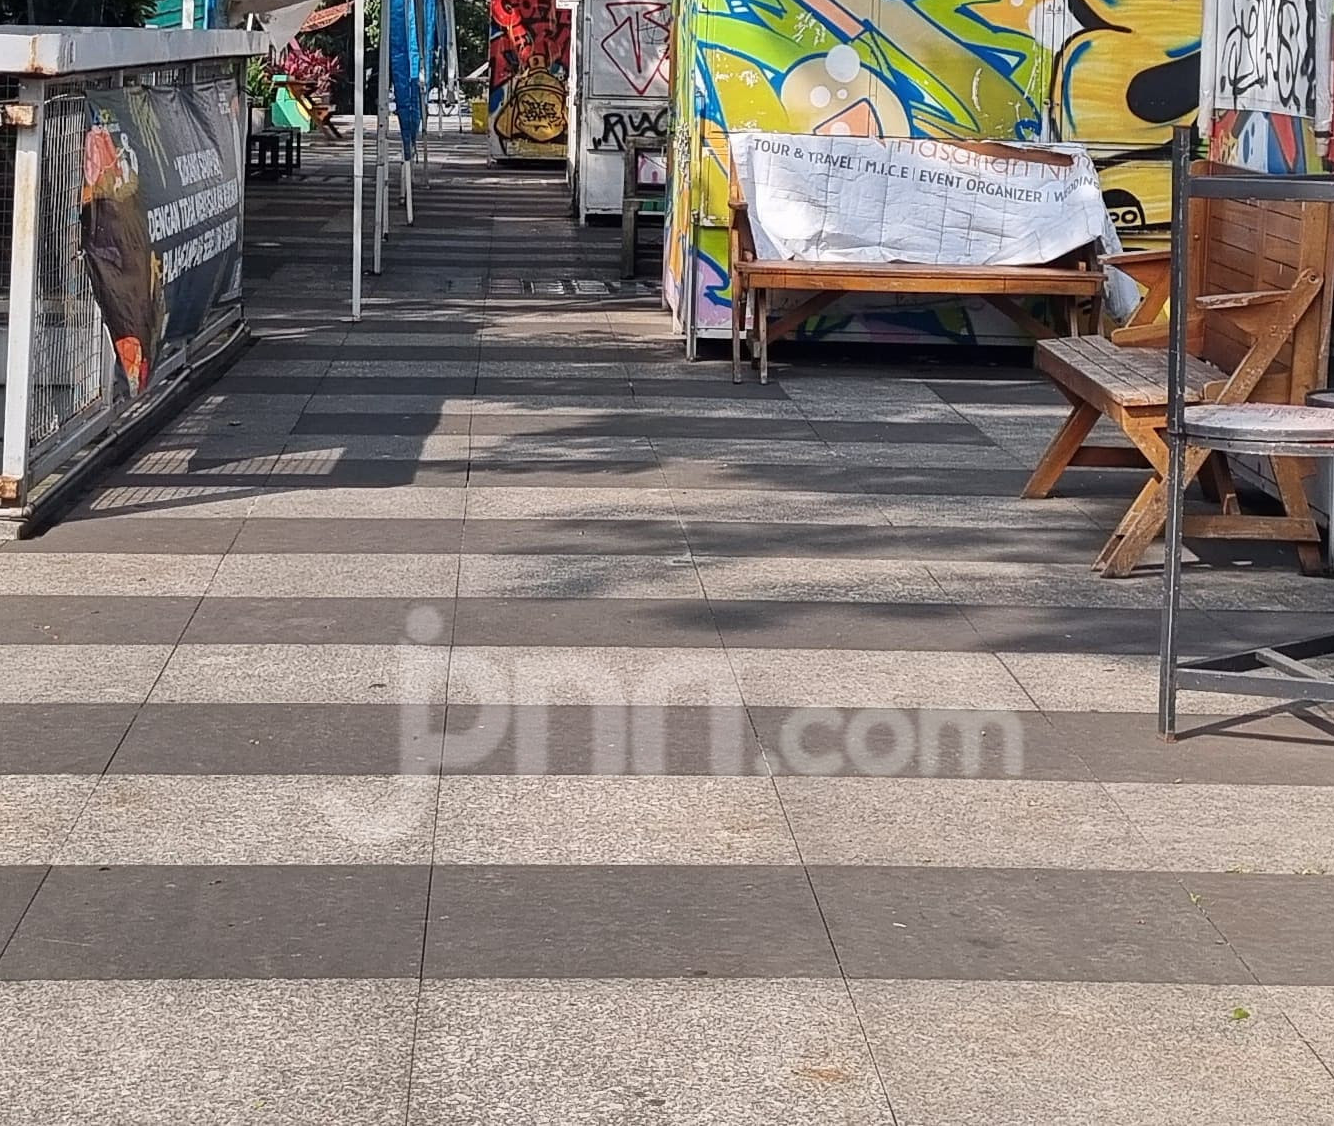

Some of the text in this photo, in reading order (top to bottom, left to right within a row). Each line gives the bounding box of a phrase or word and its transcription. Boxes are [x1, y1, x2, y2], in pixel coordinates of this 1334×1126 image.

[754, 138, 790, 157] TOUR
[793, 147, 804, 159] &
[808, 151, 854, 171] TRAVEL
[866, 161, 909, 180] M.I.C.E
[919, 170, 962, 189] EVENT
[966, 179, 1042, 203] ORGANIZER
